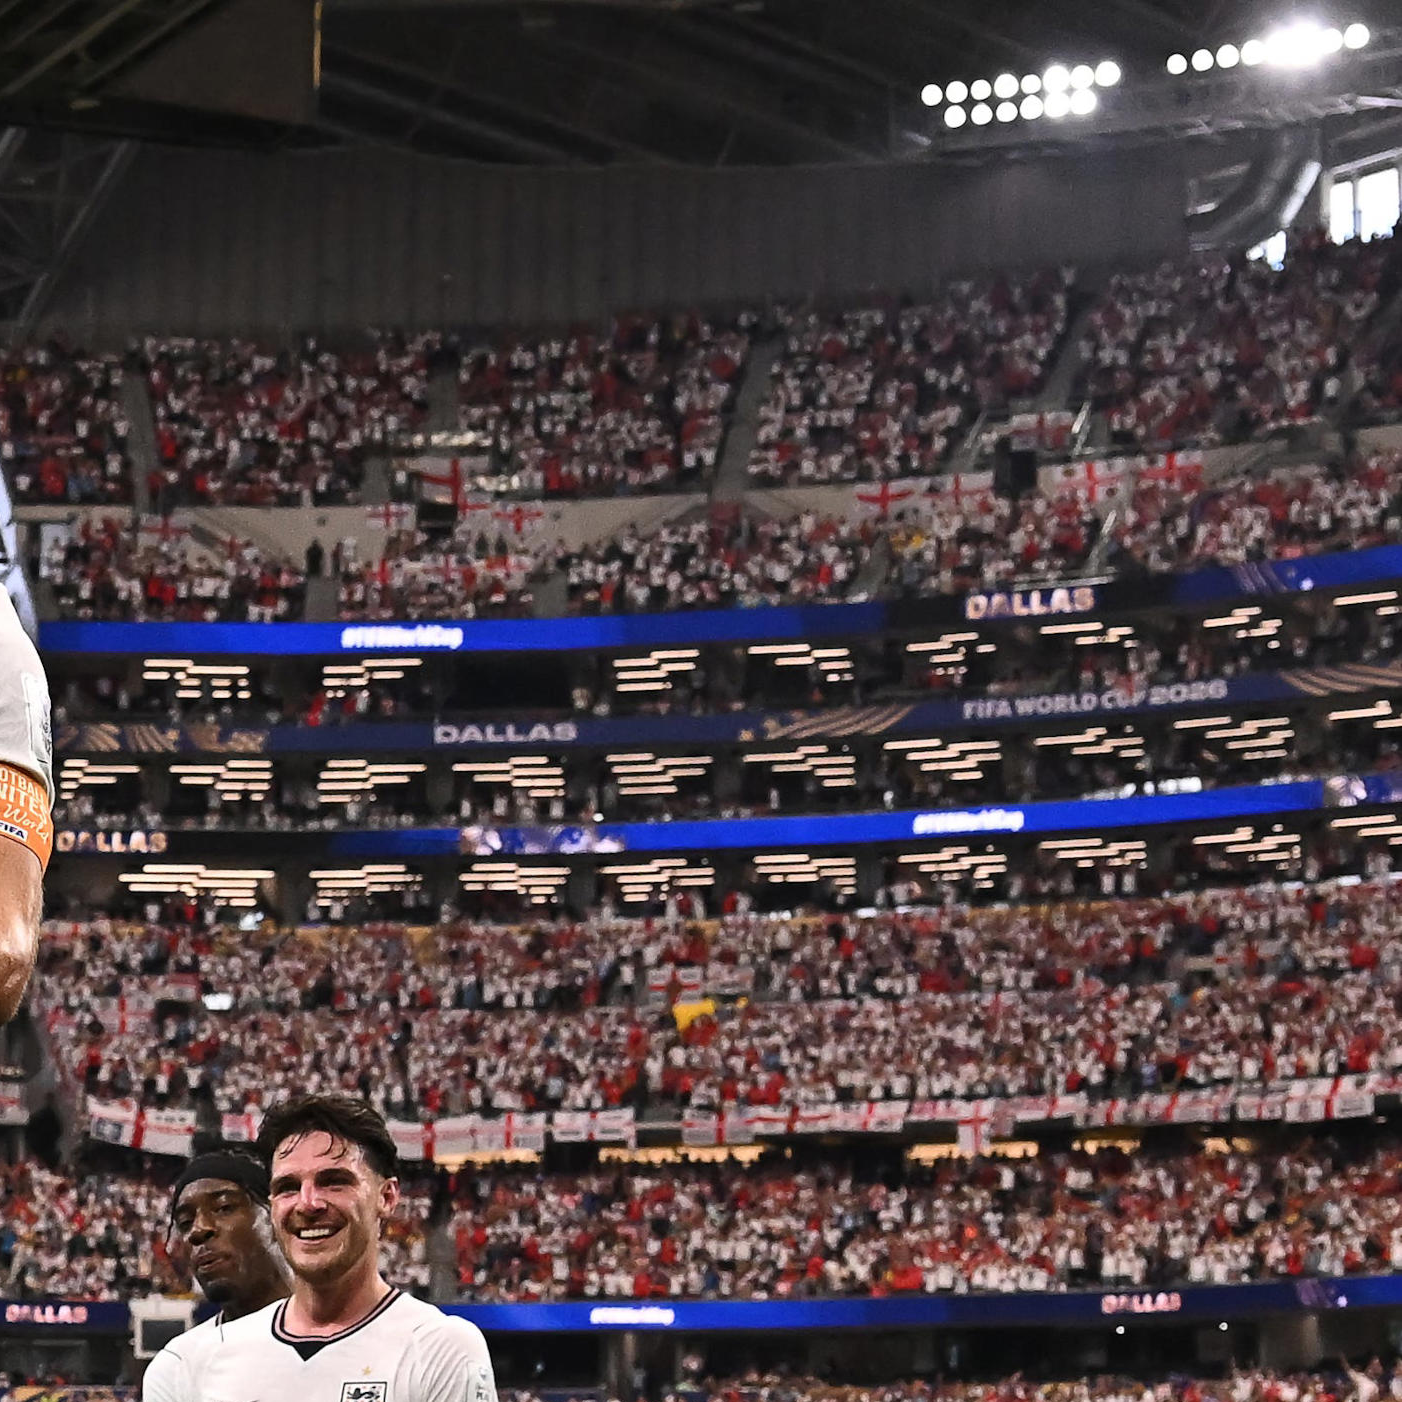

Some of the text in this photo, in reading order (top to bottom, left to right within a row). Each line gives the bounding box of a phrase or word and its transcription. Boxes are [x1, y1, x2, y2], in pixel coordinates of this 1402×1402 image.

[965, 586, 1095, 620] DALLAS
[962, 700, 1013, 721] FIFA
[1014, 693, 1098, 715] WORLD
[434, 722, 578, 744] DALLAS
[3, 803, 49, 844] World
[56, 830, 167, 853] DALLAS
